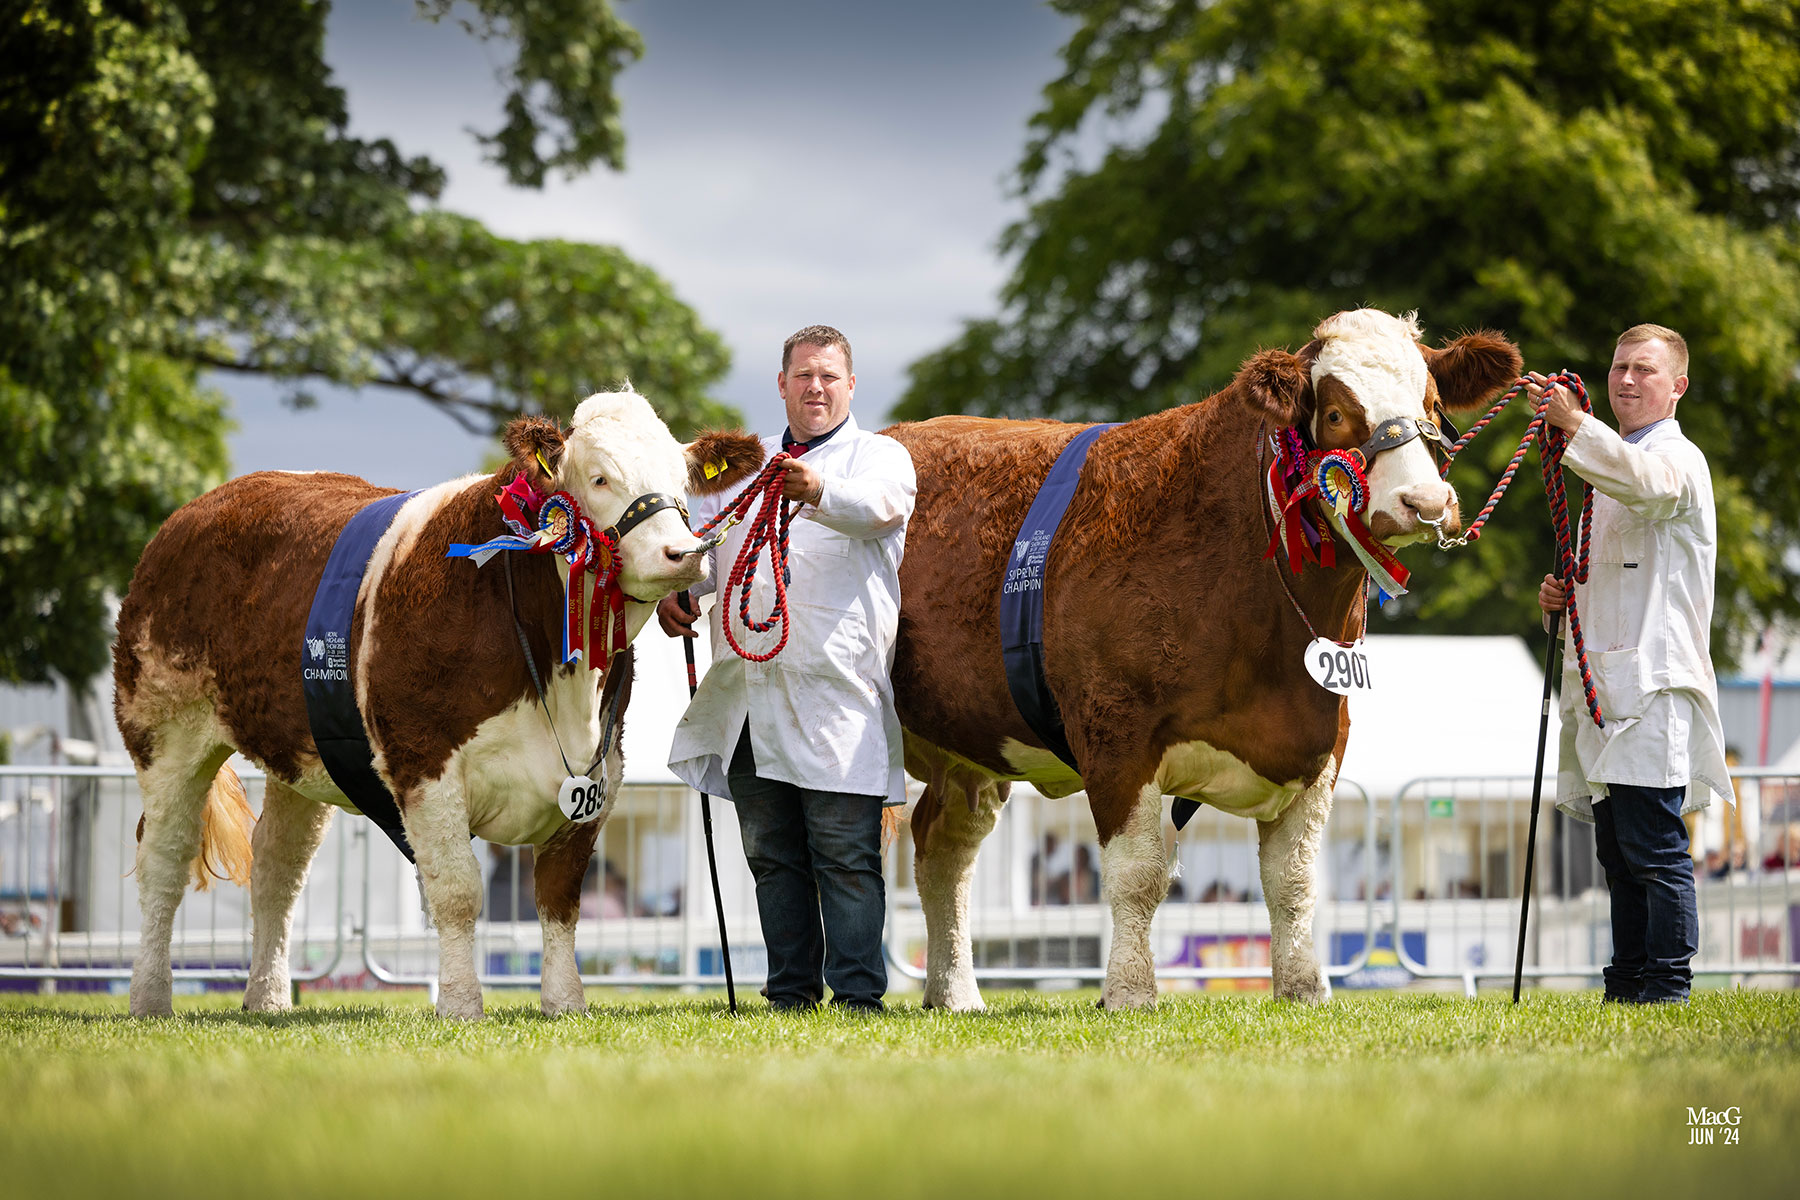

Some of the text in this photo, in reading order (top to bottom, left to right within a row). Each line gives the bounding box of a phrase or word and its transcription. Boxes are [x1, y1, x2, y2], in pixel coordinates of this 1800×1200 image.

[304, 668, 348, 680] CHAMPION
[1319, 650, 1372, 689] 2907
[570, 776, 607, 821] 289
